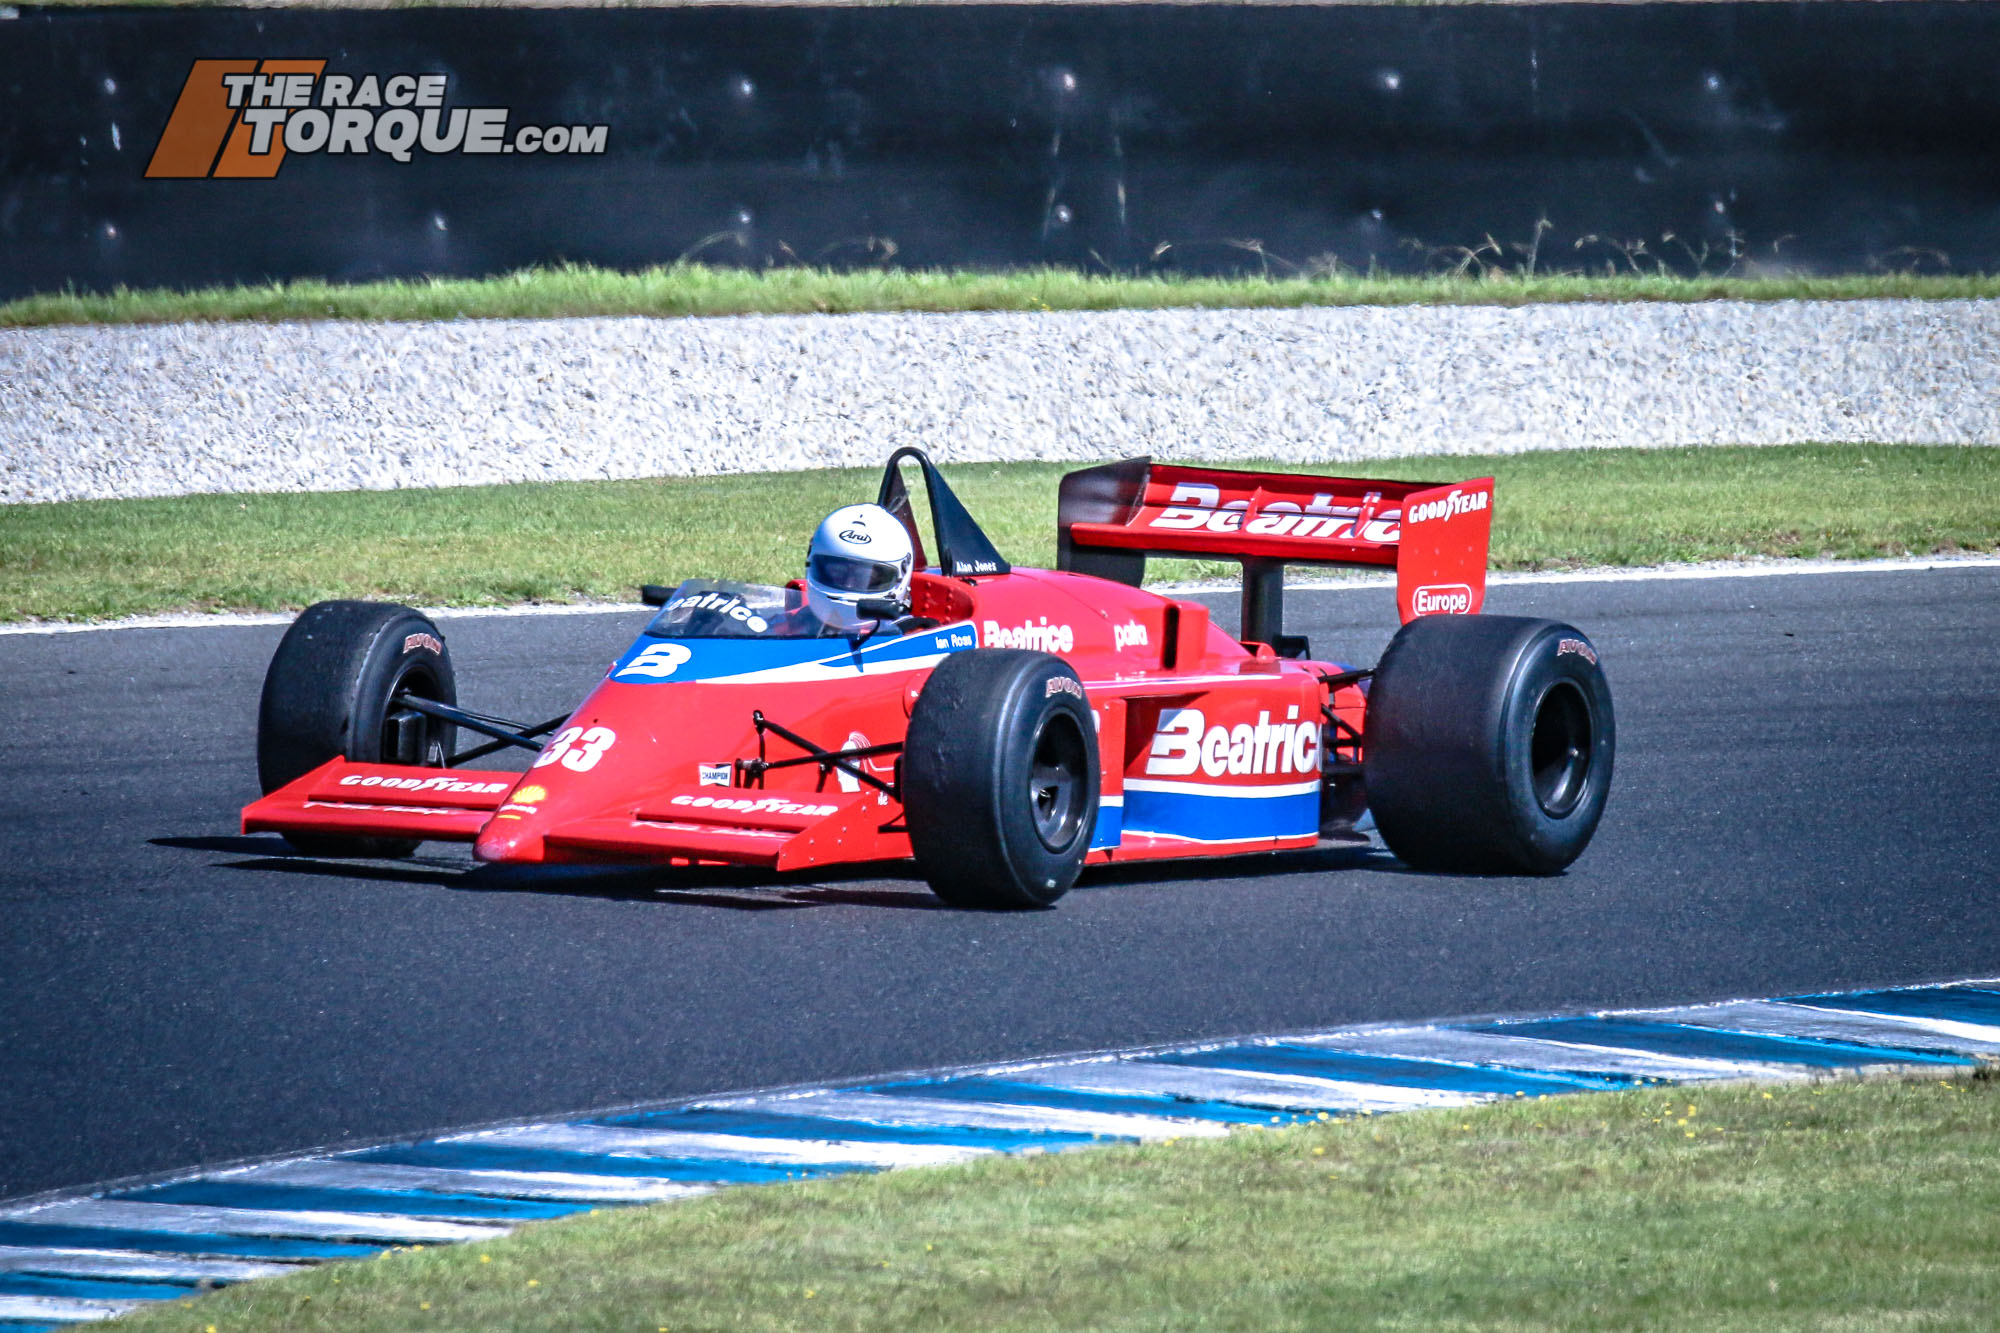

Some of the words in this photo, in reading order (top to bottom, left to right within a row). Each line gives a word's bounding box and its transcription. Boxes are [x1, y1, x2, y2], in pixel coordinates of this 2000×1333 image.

[1408, 489, 1489, 524] GOODYEAR
[956, 561, 973, 573] Alan
[975, 559, 997, 572] Jones
[1417, 590, 1467, 614] Europe
[935, 636, 949, 649] Ian
[951, 633, 973, 647] Ross
[983, 616, 1074, 654] Beatrice
[533, 726, 617, 773] 33
[339, 775, 509, 793] GOODYEAR
[701, 771, 729, 780] CHAMPION
[670, 794, 839, 816] GOODYEAR
